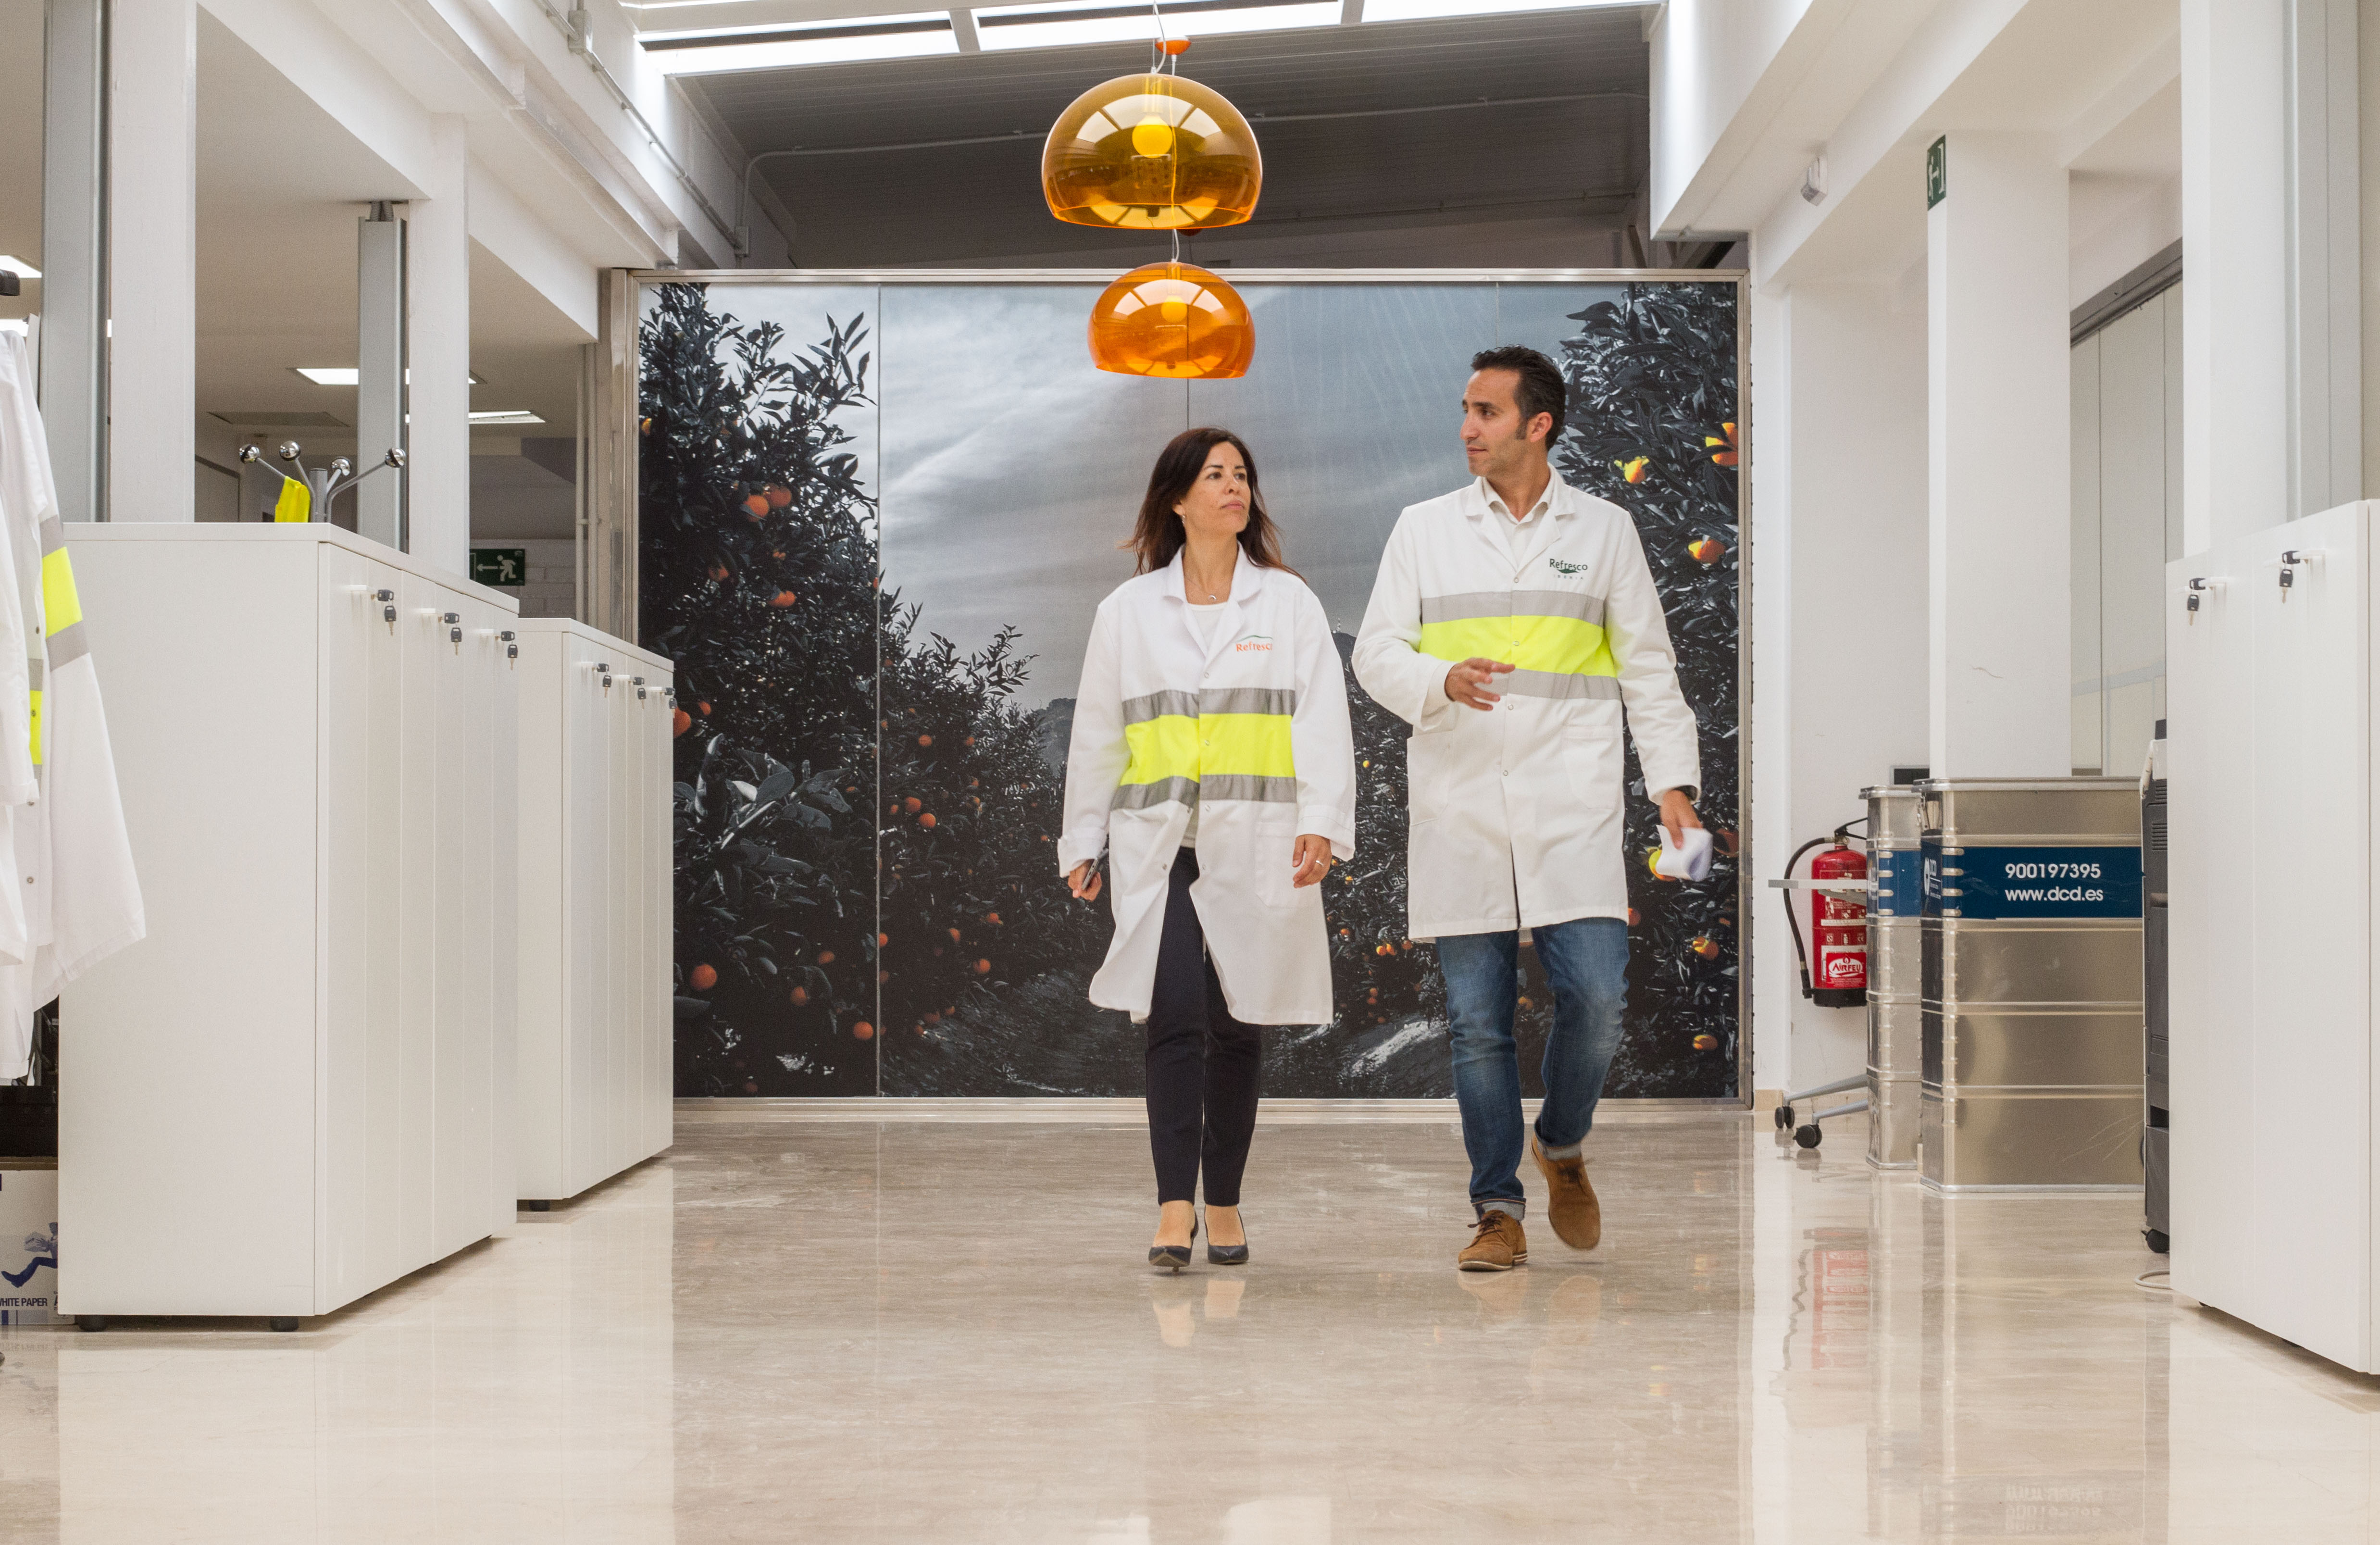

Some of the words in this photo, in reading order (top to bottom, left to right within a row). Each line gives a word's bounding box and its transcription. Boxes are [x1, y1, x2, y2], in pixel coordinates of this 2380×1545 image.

[1549, 558, 1588, 571] Refresco
[2005, 863, 2101, 879] 900197395
[2005, 886, 2104, 901] www.dcd.es
[21, 1298, 48, 1307] PAPER
